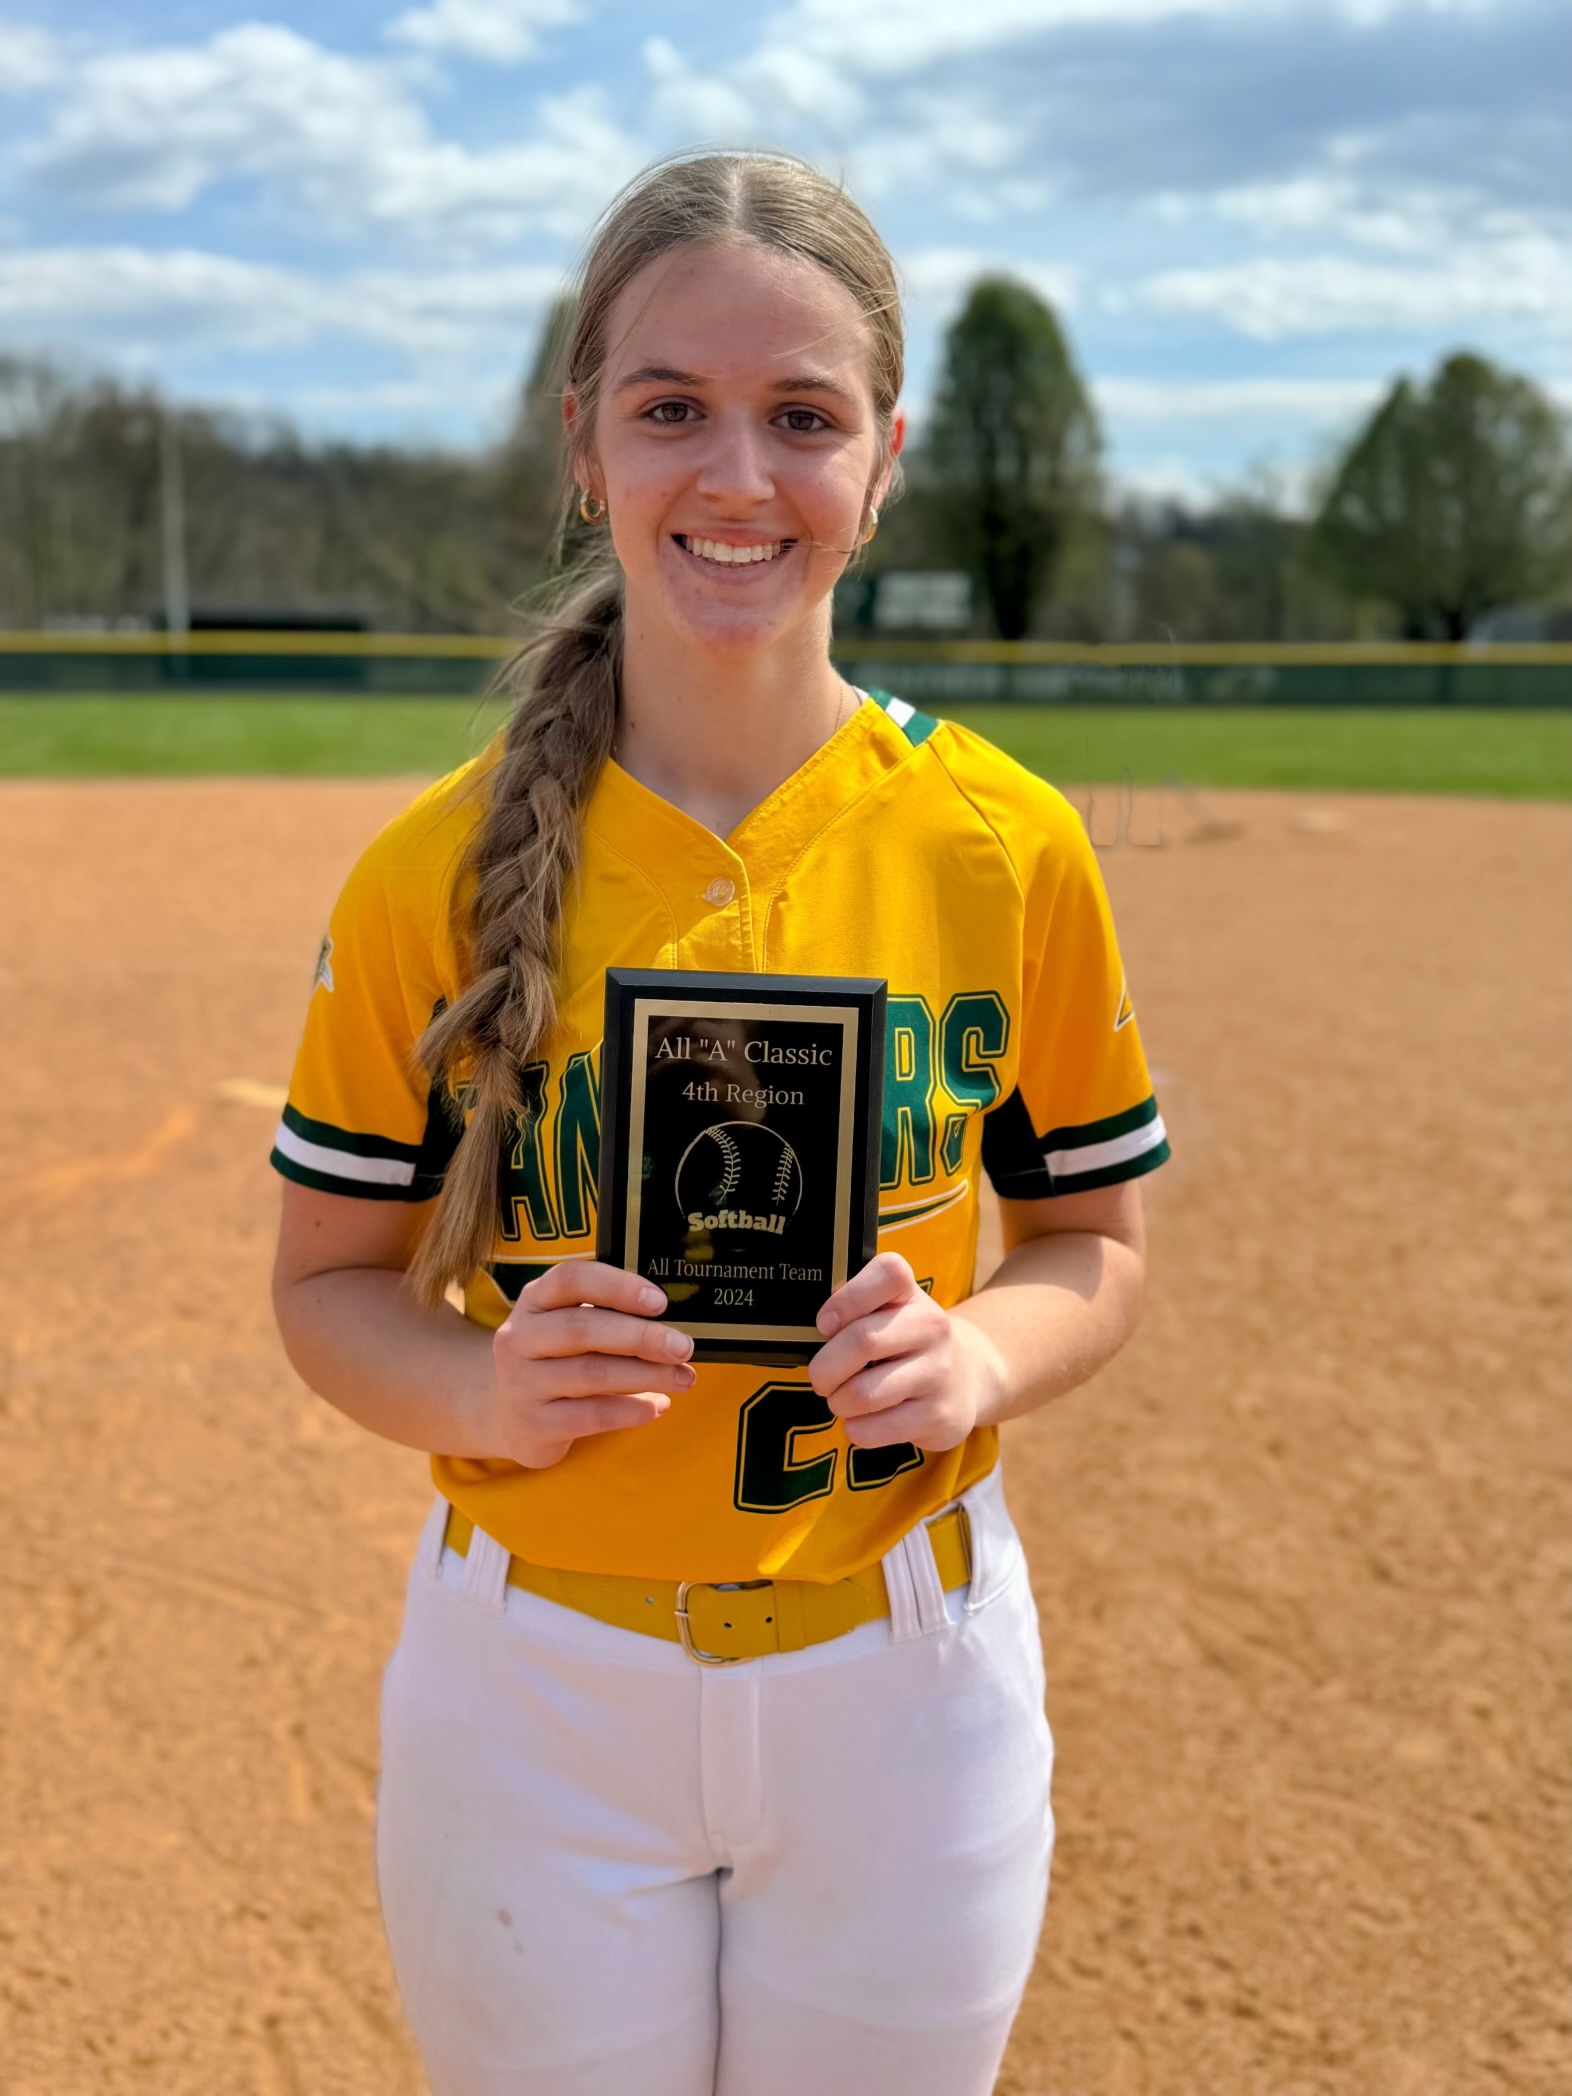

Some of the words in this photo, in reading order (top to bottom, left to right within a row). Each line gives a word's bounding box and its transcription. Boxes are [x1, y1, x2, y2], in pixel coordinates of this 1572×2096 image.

[654, 1037, 692, 1060] All
[700, 1038, 736, 1062] "A"
[743, 1040, 833, 1066] Classic
[681, 1081, 719, 1102] 4th
[725, 1083, 805, 1109] Region
[687, 1209, 787, 1235] Softball
[647, 1258, 669, 1276] All
[673, 1259, 775, 1280] Tournament
[778, 1262, 823, 1282] Team
[713, 1287, 754, 1306] 2024
